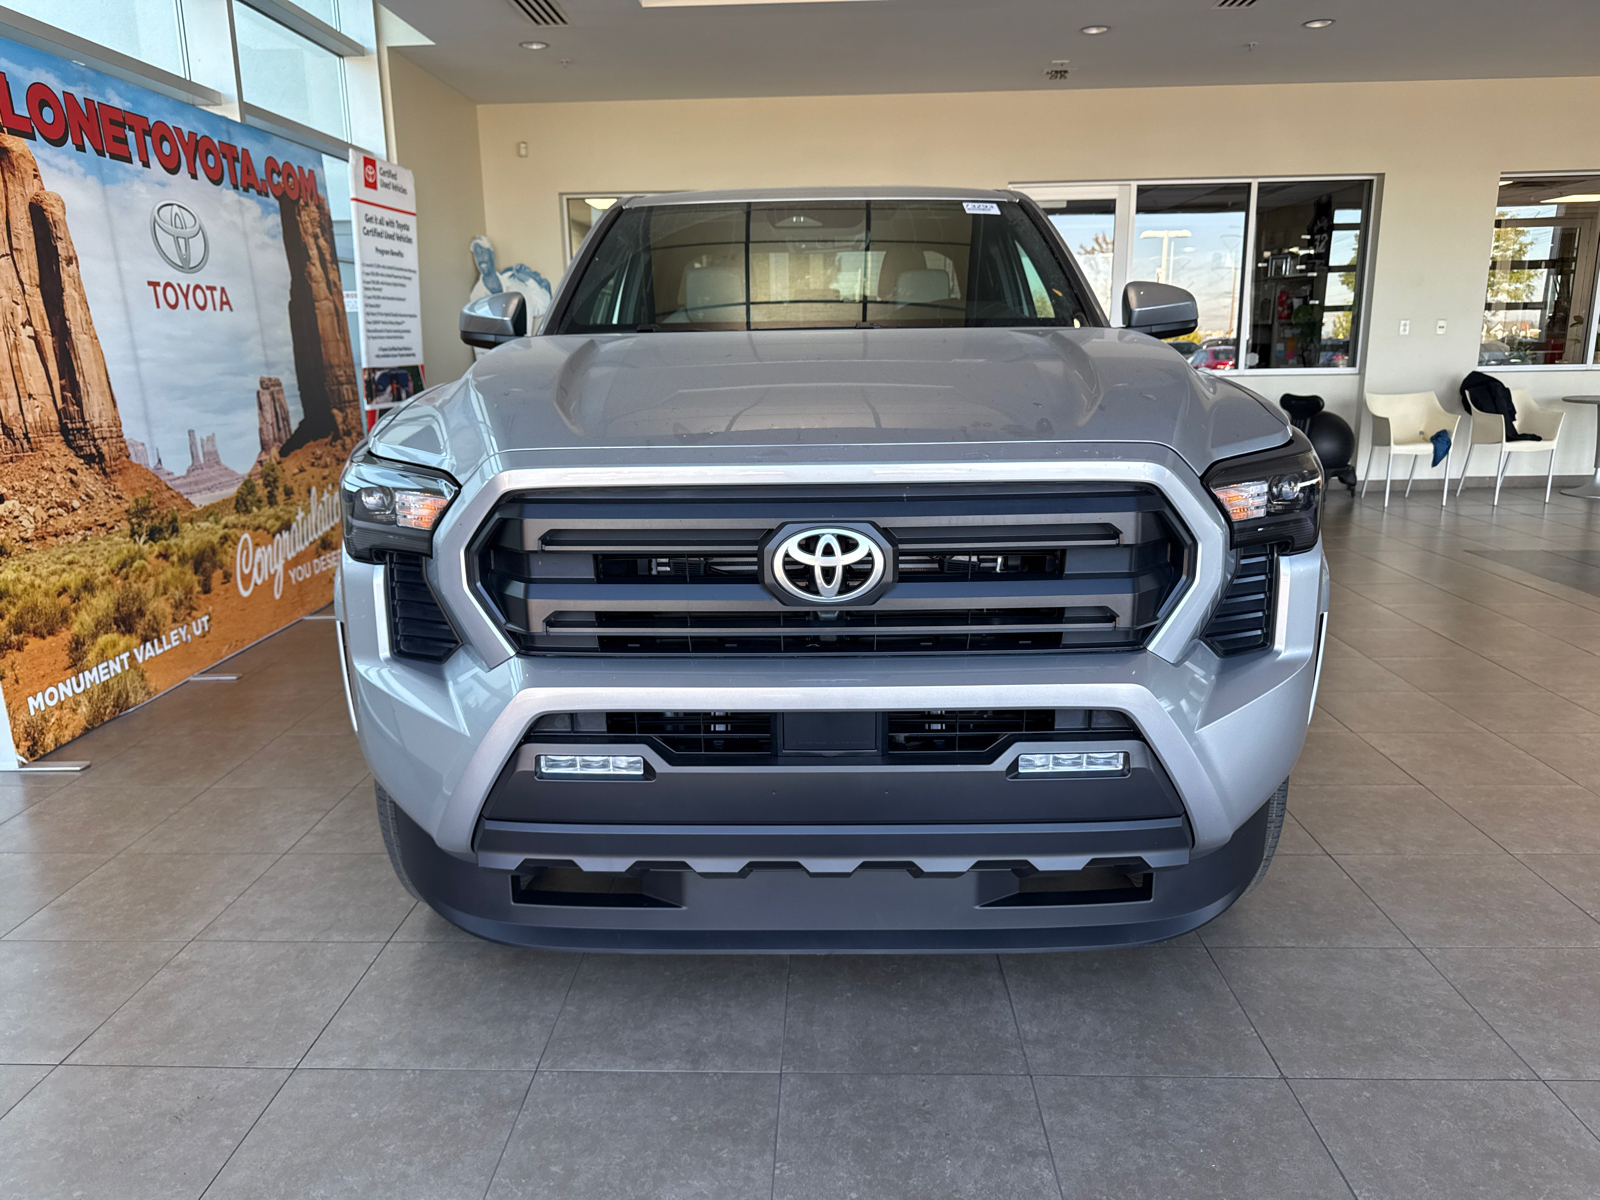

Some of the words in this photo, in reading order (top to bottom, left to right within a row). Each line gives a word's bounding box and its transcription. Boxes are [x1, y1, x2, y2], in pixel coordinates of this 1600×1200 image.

[146, 280, 234, 312] TOYOTA
[288, 562, 312, 585] YOU
[27, 651, 130, 717] MONUMENT
[132, 624, 191, 664] VALLEY,
[192, 615, 211, 636] UT
